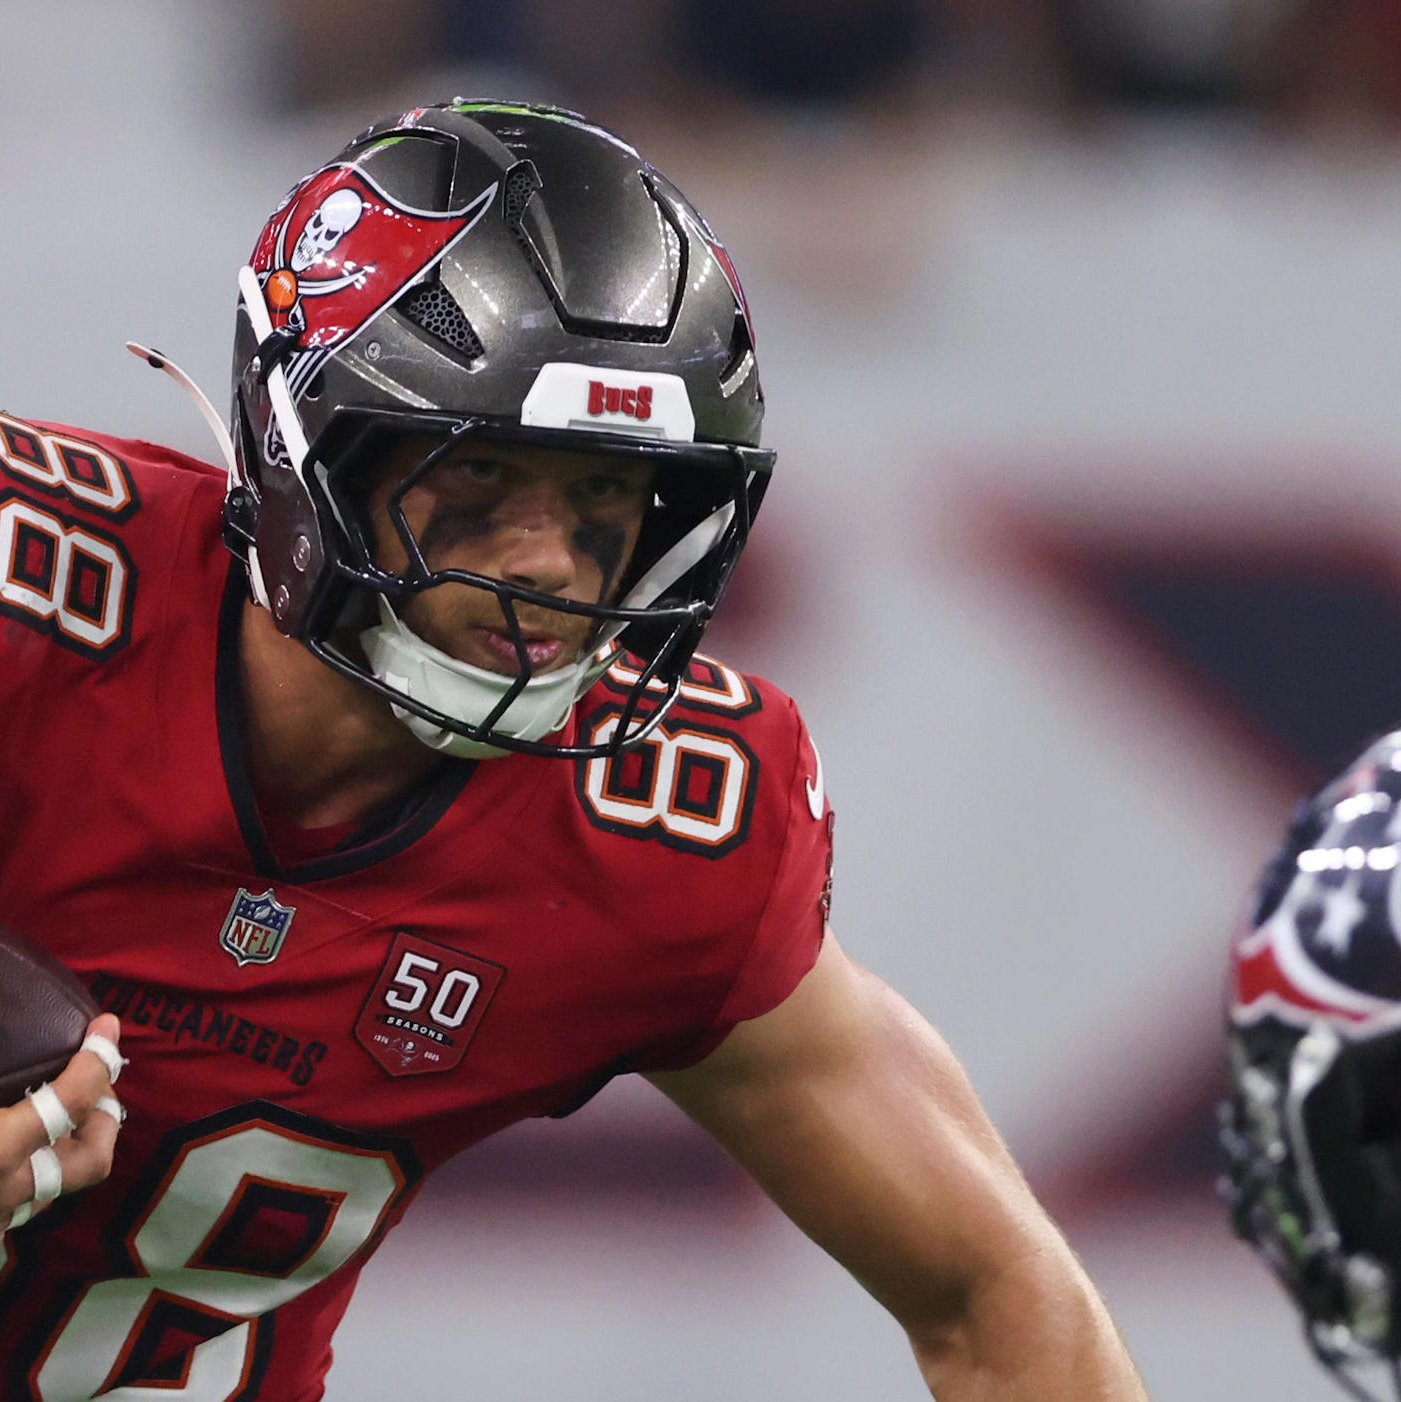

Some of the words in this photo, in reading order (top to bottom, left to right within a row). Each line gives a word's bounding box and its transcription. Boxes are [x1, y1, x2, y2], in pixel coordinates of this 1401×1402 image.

[228, 919, 274, 955] NFL
[385, 951, 480, 1028] 50
[386, 1015, 445, 1042] SEASONS
